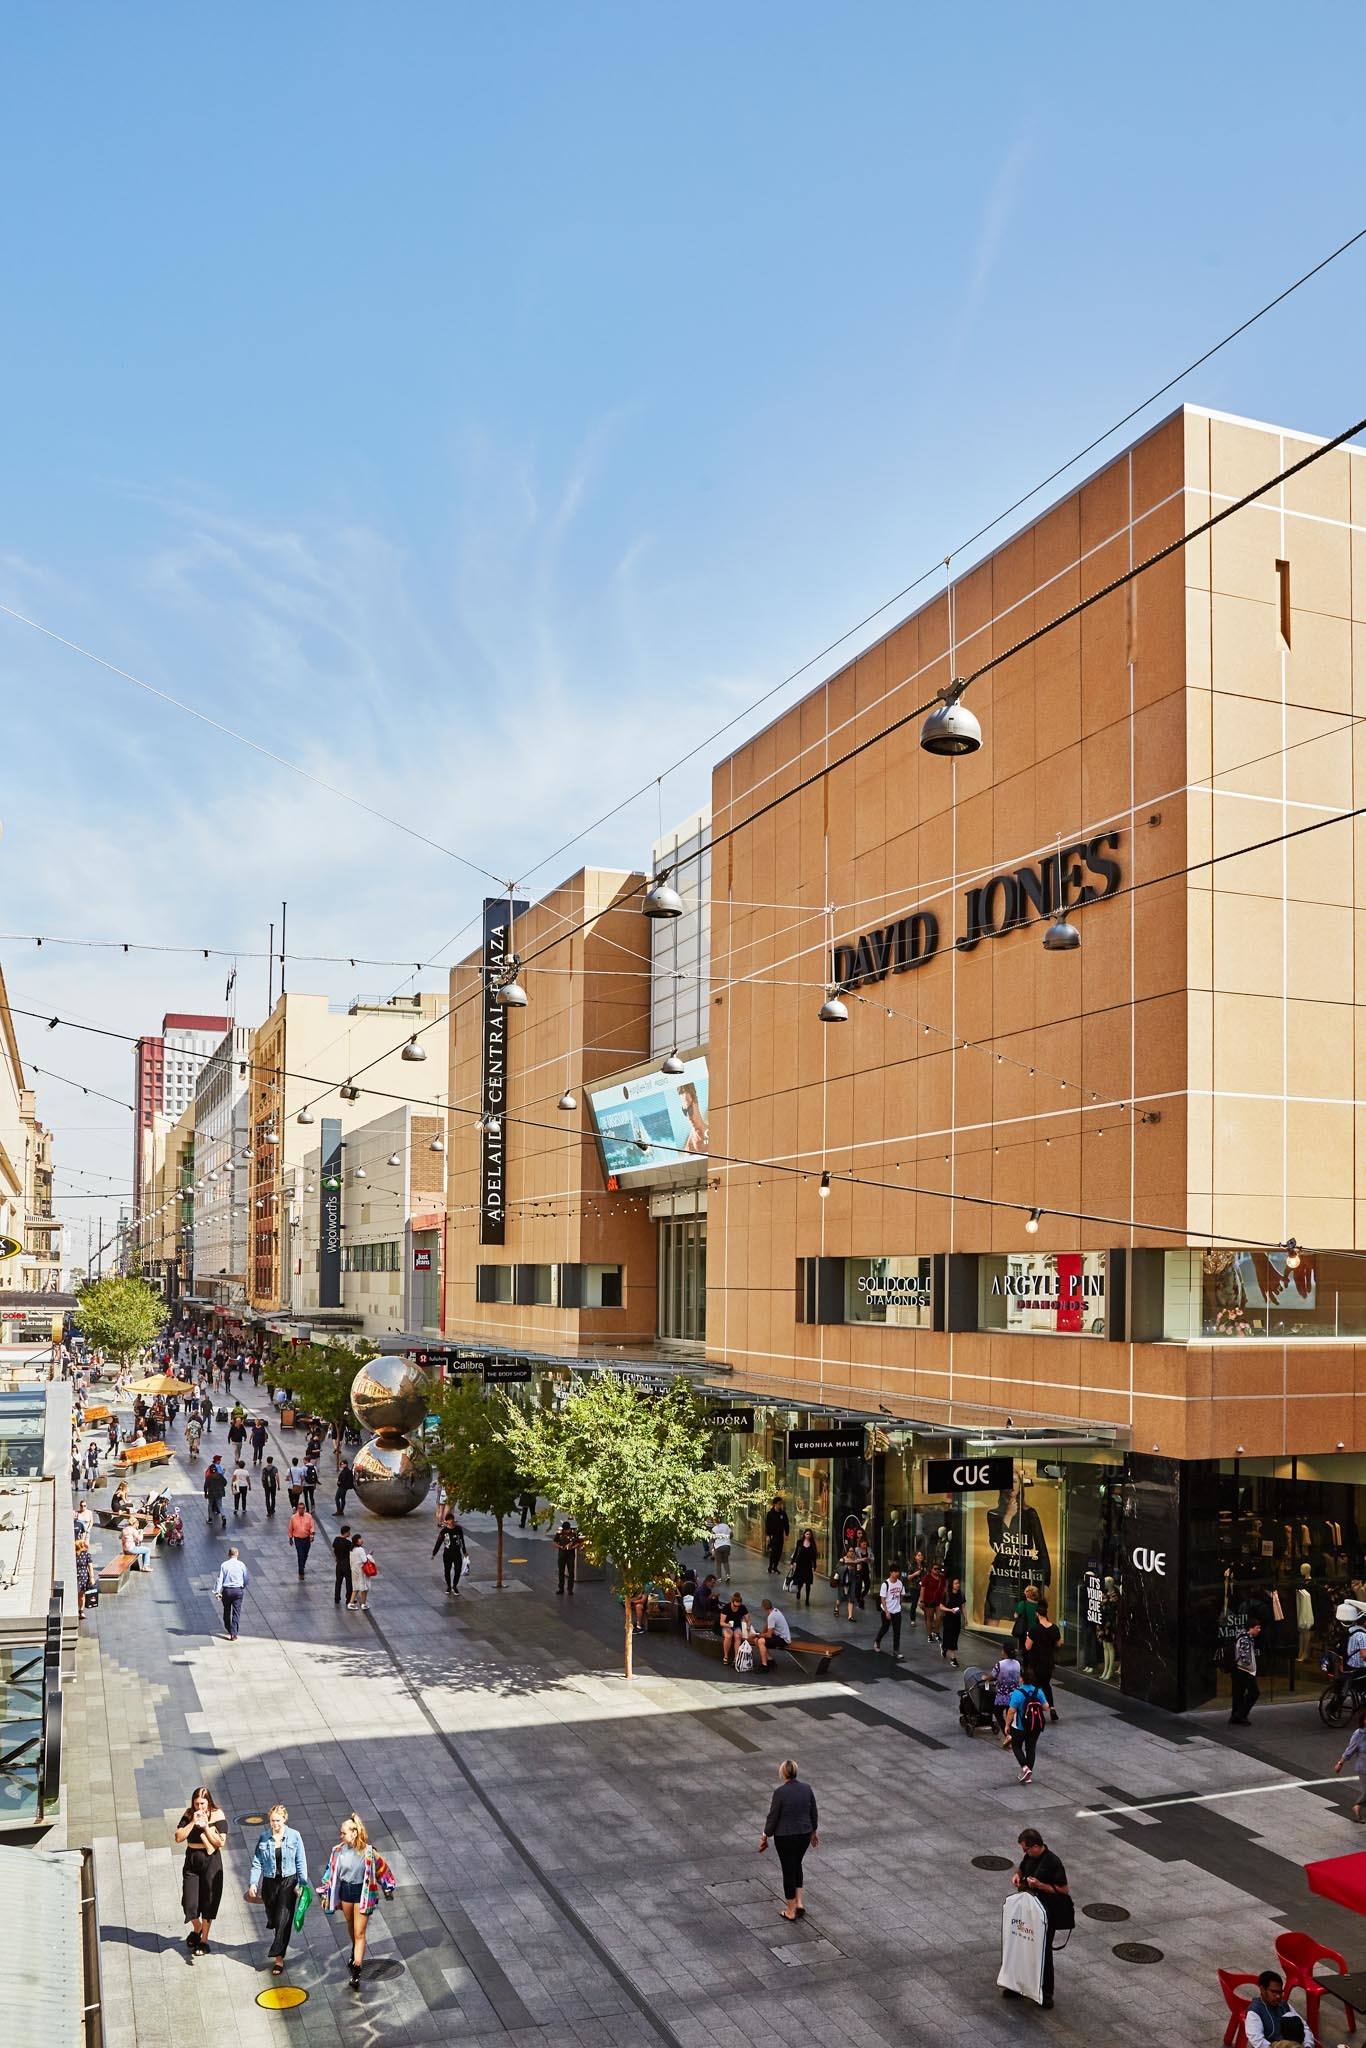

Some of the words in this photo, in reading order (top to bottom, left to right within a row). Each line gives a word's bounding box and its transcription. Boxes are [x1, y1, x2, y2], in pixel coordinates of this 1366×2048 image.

[828, 911, 939, 996] DAVID
[956, 830, 1121, 951] JONES
[488, 1004, 503, 1103] CENTRAL
[327, 1196, 338, 1254] Woolworths
[991, 1275, 1060, 1297] ARGYLE
[866, 1294, 926, 1307] DIAMONDS
[1016, 1299, 1090, 1311] DIAMONDS
[2, 1311, 27, 1320] coles
[453, 1361, 484, 1370] Calibre
[836, 1440, 860, 1448] MAINE
[952, 1465, 990, 1486] CUE
[1002, 1531, 1029, 1546] Still
[993, 1541, 1040, 1560] Making
[1008, 1555, 1021, 1567] in
[1132, 1547, 1167, 1576] CUE
[990, 1565, 1044, 1582] Australia
[1089, 1576, 1101, 1589] IT'S
[1086, 1589, 1103, 1602] YOUR
[1088, 1599, 1101, 1613] CUE
[1086, 1610, 1103, 1625] SALE
